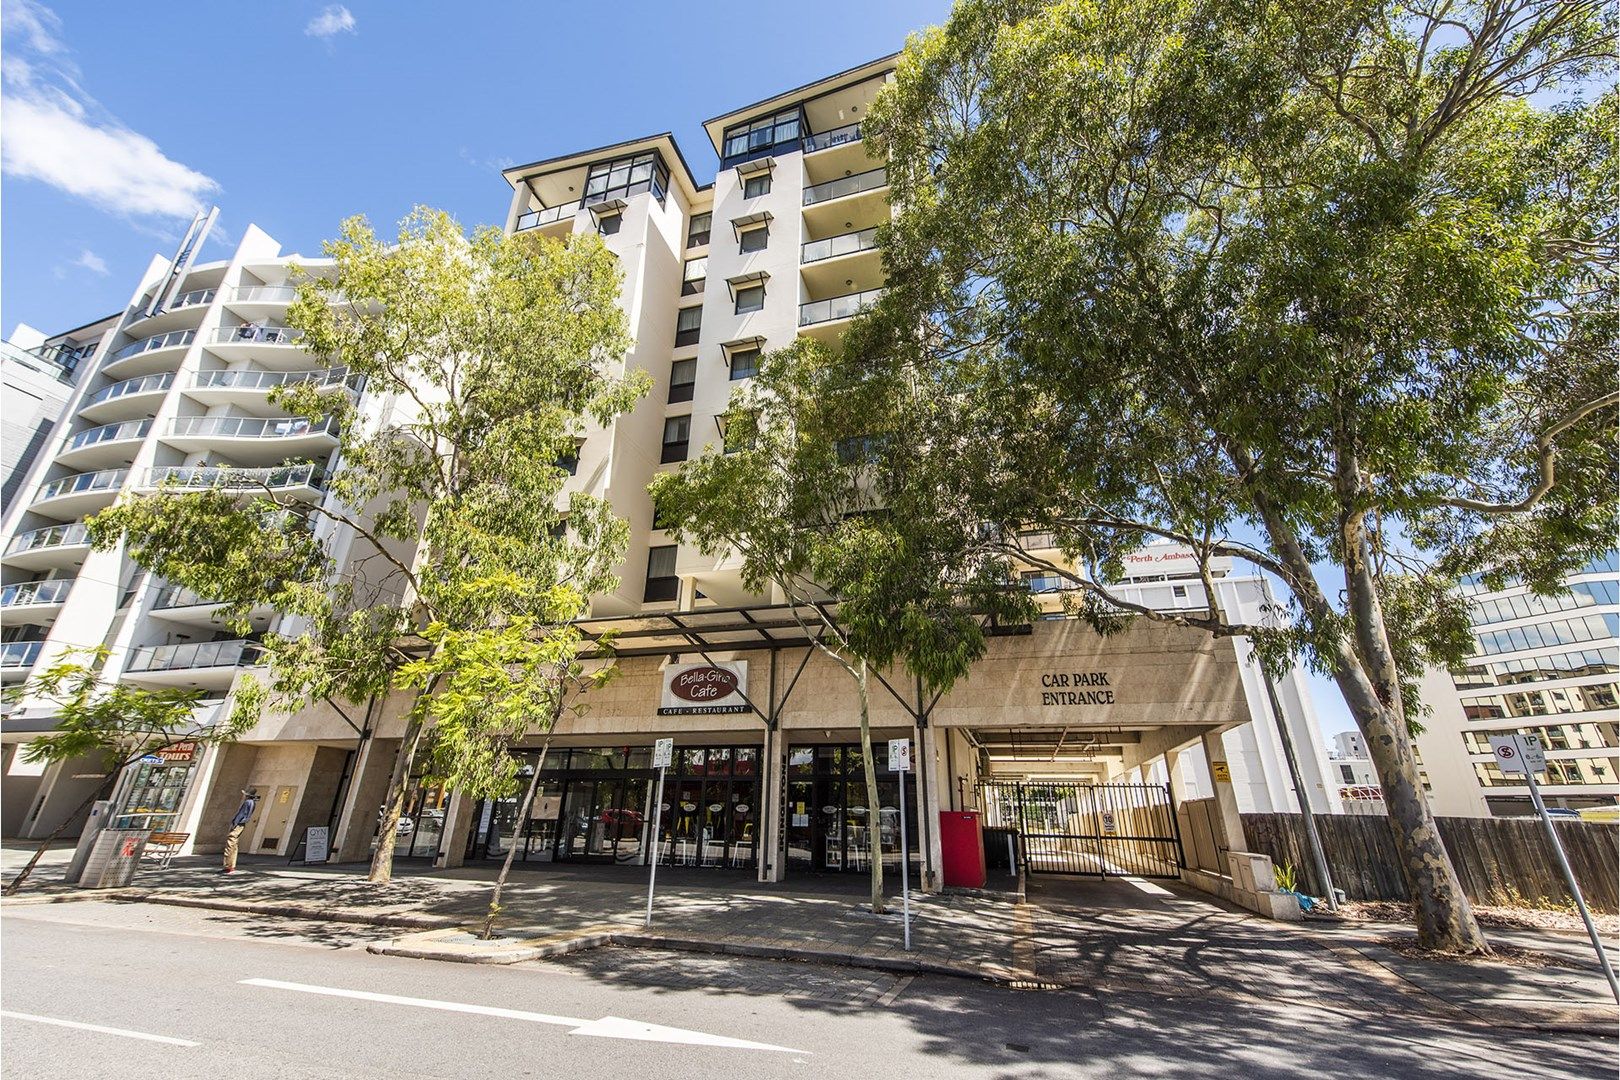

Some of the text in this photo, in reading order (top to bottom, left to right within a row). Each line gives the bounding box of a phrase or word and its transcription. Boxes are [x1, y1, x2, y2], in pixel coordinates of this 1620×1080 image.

[1127, 552, 1192, 563] Perth Ambas
[1041, 672, 1111, 688] CAR PARK
[690, 684, 718, 698] Cafe
[1041, 690, 1115, 706] ENTRANCE
[692, 706, 745, 714] RESTAURANT
[1523, 736, 1537, 746] 1P
[159, 752, 191, 761] Tours
